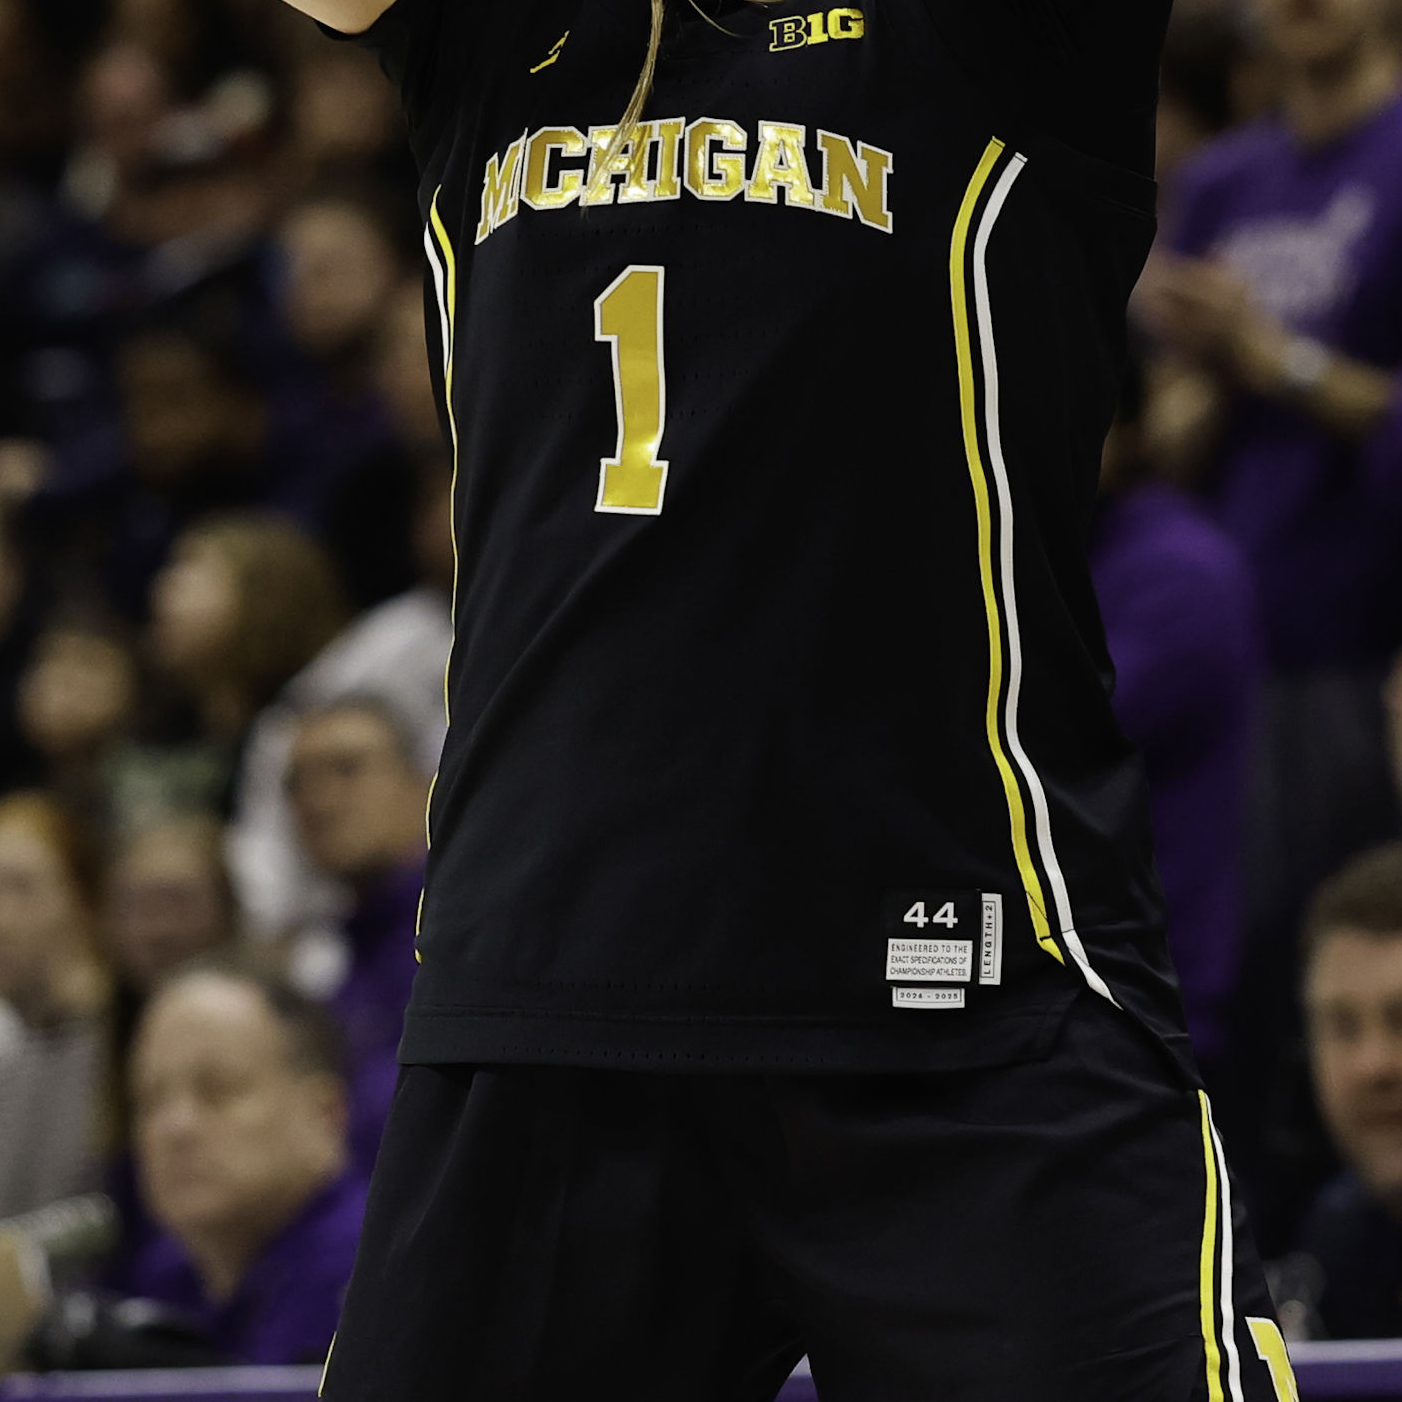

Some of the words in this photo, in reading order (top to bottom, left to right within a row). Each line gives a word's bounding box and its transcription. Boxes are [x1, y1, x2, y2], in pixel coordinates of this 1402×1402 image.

[474, 116, 894, 246] MCHIGAN
[594, 265, 669, 516] 1
[903, 901, 959, 929] 44
[890, 955, 909, 964] EXACT
[891, 943, 939, 953] ENGINEERED
[941, 944, 951, 953] TO
[954, 945, 968, 954] THE
